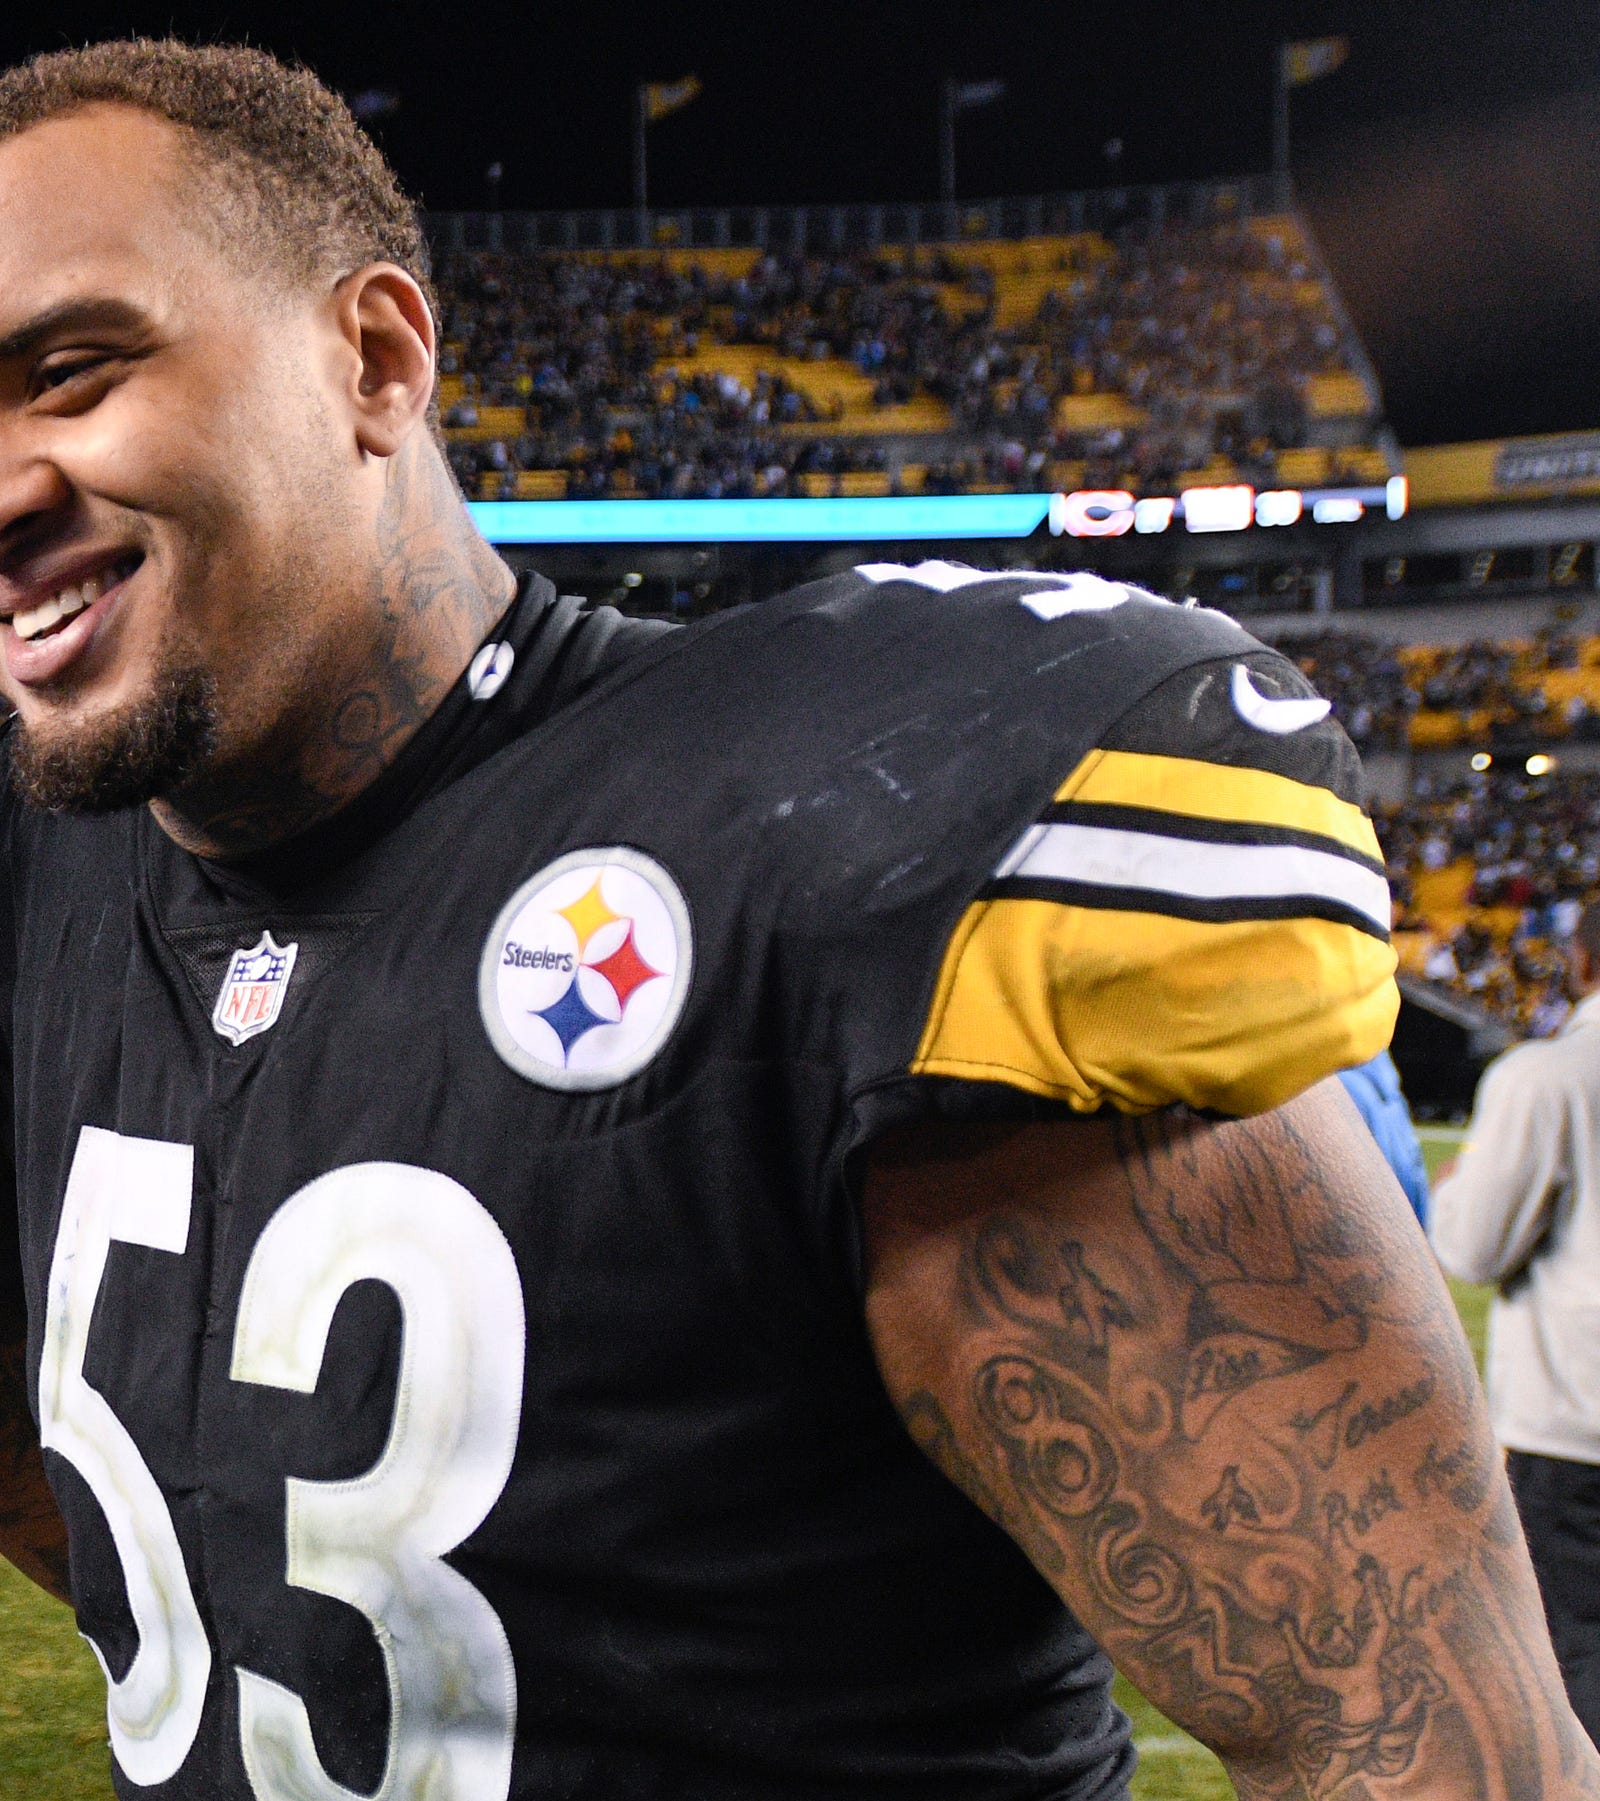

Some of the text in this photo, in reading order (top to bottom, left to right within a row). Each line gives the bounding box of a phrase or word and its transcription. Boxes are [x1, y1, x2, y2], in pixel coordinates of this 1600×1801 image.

[503, 941, 573, 972] Steelers
[225, 985, 272, 1024] NFL
[38, 1124, 527, 1801] 53
